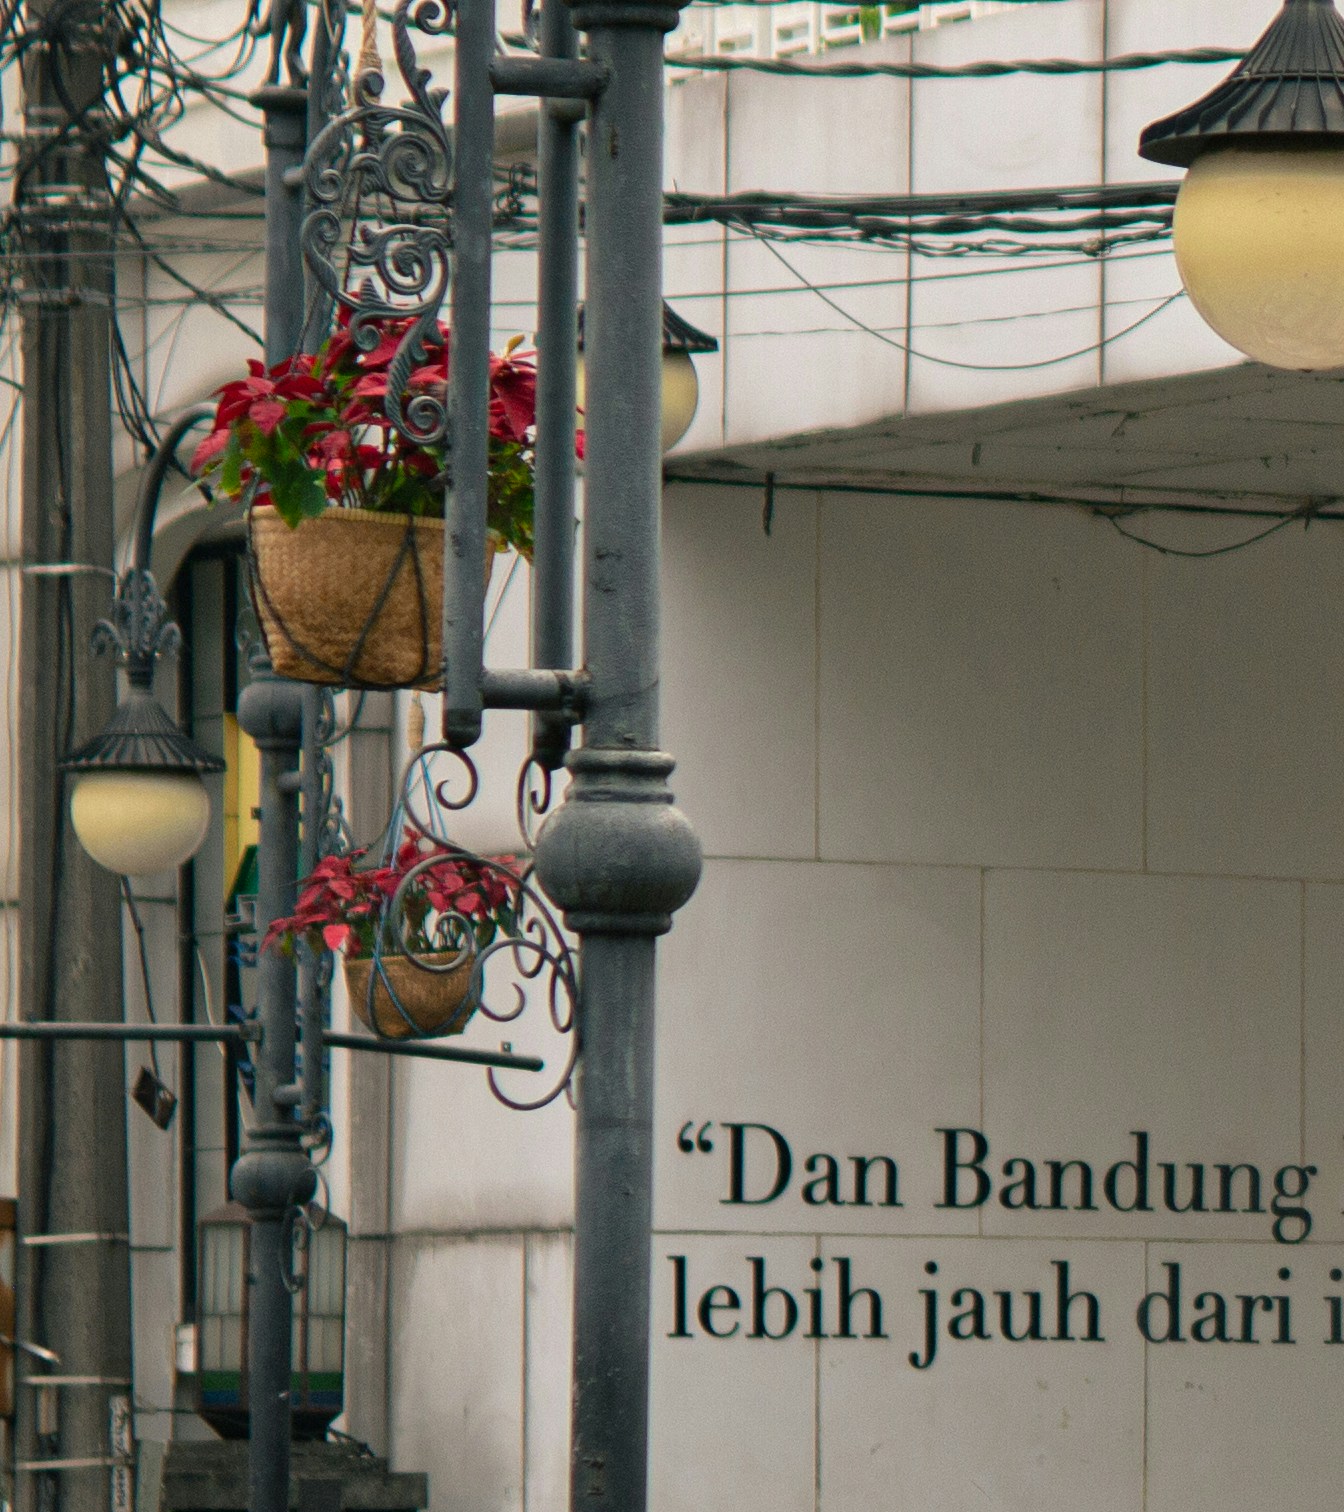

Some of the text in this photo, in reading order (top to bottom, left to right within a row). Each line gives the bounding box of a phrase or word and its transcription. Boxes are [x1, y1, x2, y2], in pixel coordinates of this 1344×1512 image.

[676, 1120, 905, 1208] “Dan
[933, 1127, 1319, 1245] Bandung
[667, 1255, 889, 1341] lebih
[907, 1260, 1106, 1370] jauh
[1135, 1262, 1297, 1345] dari
